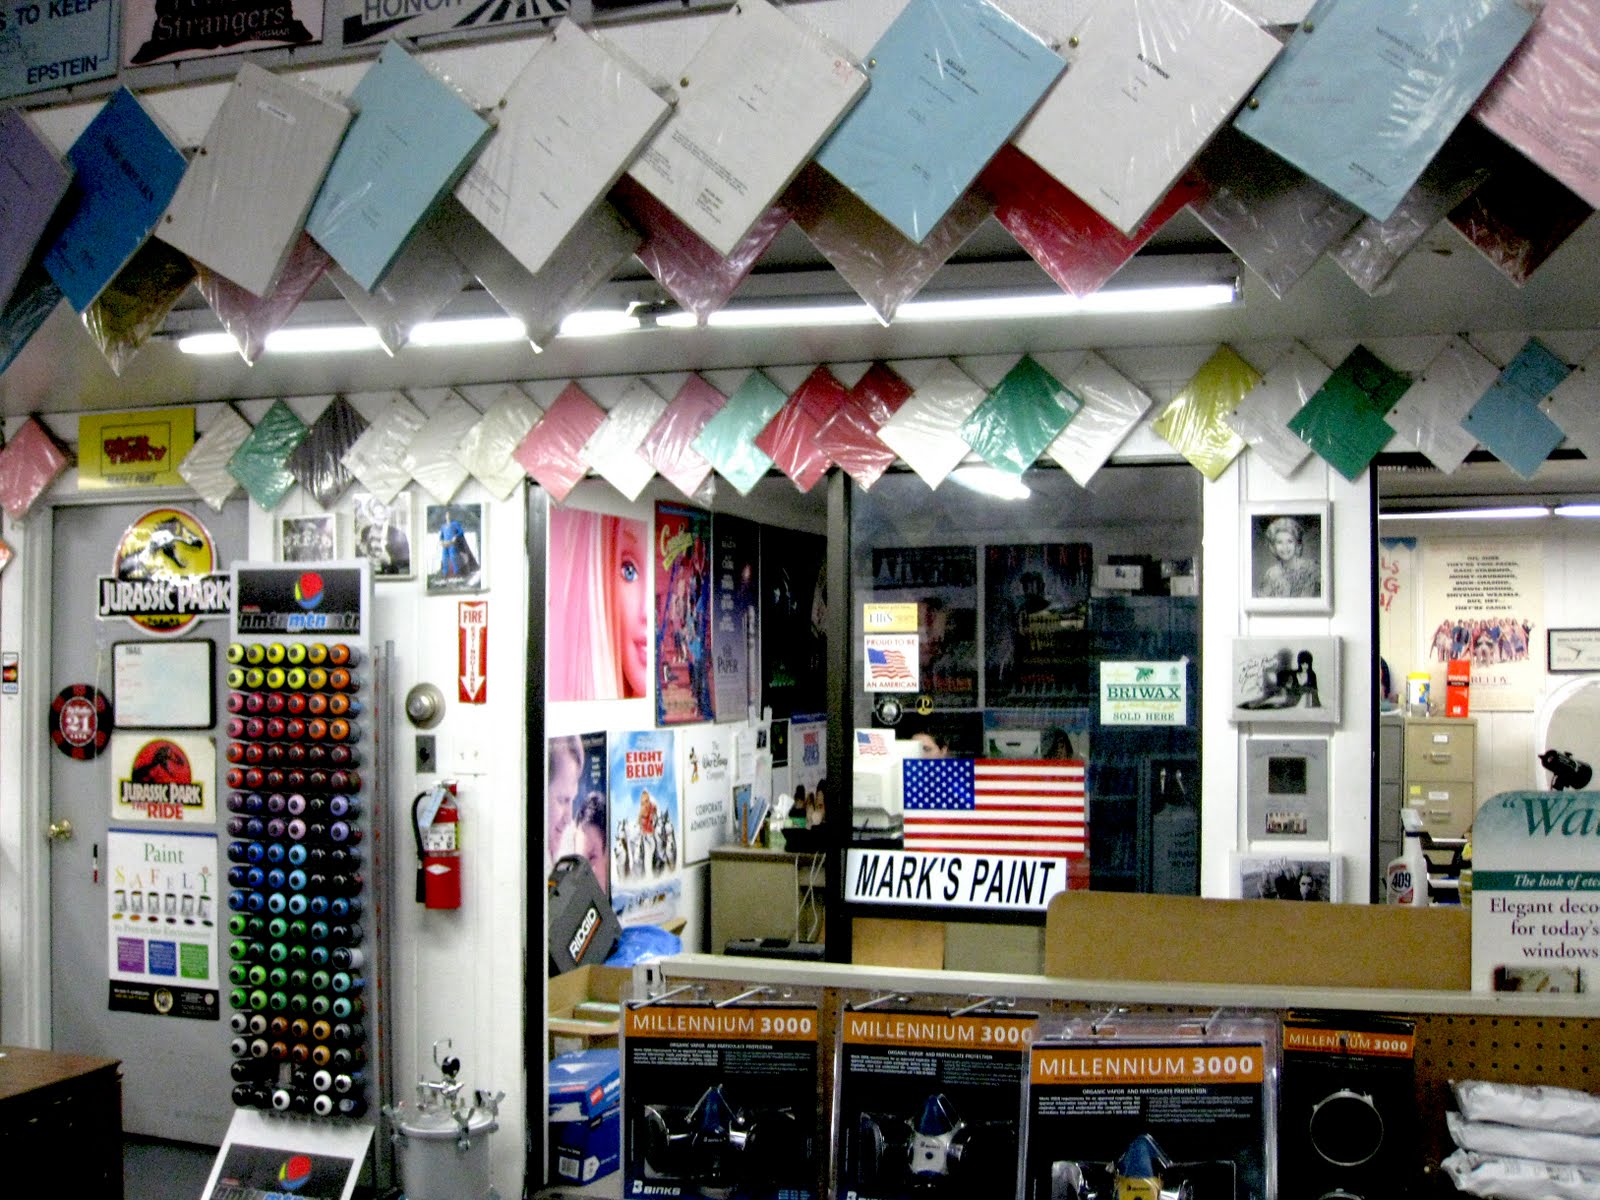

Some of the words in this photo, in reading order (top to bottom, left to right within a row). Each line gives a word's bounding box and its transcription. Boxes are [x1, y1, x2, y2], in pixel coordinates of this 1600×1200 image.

[15, 4, 40, 25] TO
[158, 6, 286, 41] Strangers
[27, 55, 98, 85] EPSTEIN
[101, 580, 175, 615] JURASSIC
[177, 578, 231, 613] PARK
[463, 610, 483, 624] FIRE
[717, 656, 739, 674] PAPER
[1107, 686, 1180, 699] BRIWAX
[1113, 711, 1141, 721] SOLD
[1146, 711, 1175, 721] HERE
[625, 750, 663, 763] EIGHT
[626, 763, 664, 779] BELOW
[122, 782, 168, 803] JURASSIC
[170, 783, 202, 805] PARK
[147, 803, 184, 820] RIDE
[144, 843, 185, 864] Paint
[855, 854, 962, 901] MARK'S
[969, 858, 1056, 905] PAINT
[1391, 871, 1412, 889] 409
[1514, 874, 1536, 887] The
[1538, 874, 1565, 887] look
[1566, 874, 1582, 891] of
[1490, 897, 1553, 918] Elegant
[569, 908, 597, 960] RIDGID
[1511, 919, 1536, 936] for
[1542, 919, 1600, 941] today's
[1522, 941, 1600, 958] windows
[632, 1014, 754, 1033] MILLENNIUM
[760, 1016, 812, 1035] 3000
[850, 1020, 975, 1042] MILLENNIUM
[980, 1026, 1033, 1043] 3000
[1289, 1033, 1371, 1049] MILLENIUM
[1374, 1040, 1408, 1052] 3000
[1039, 1056, 1185, 1076] MILLENNIUM
[1191, 1055, 1254, 1075] 3000
